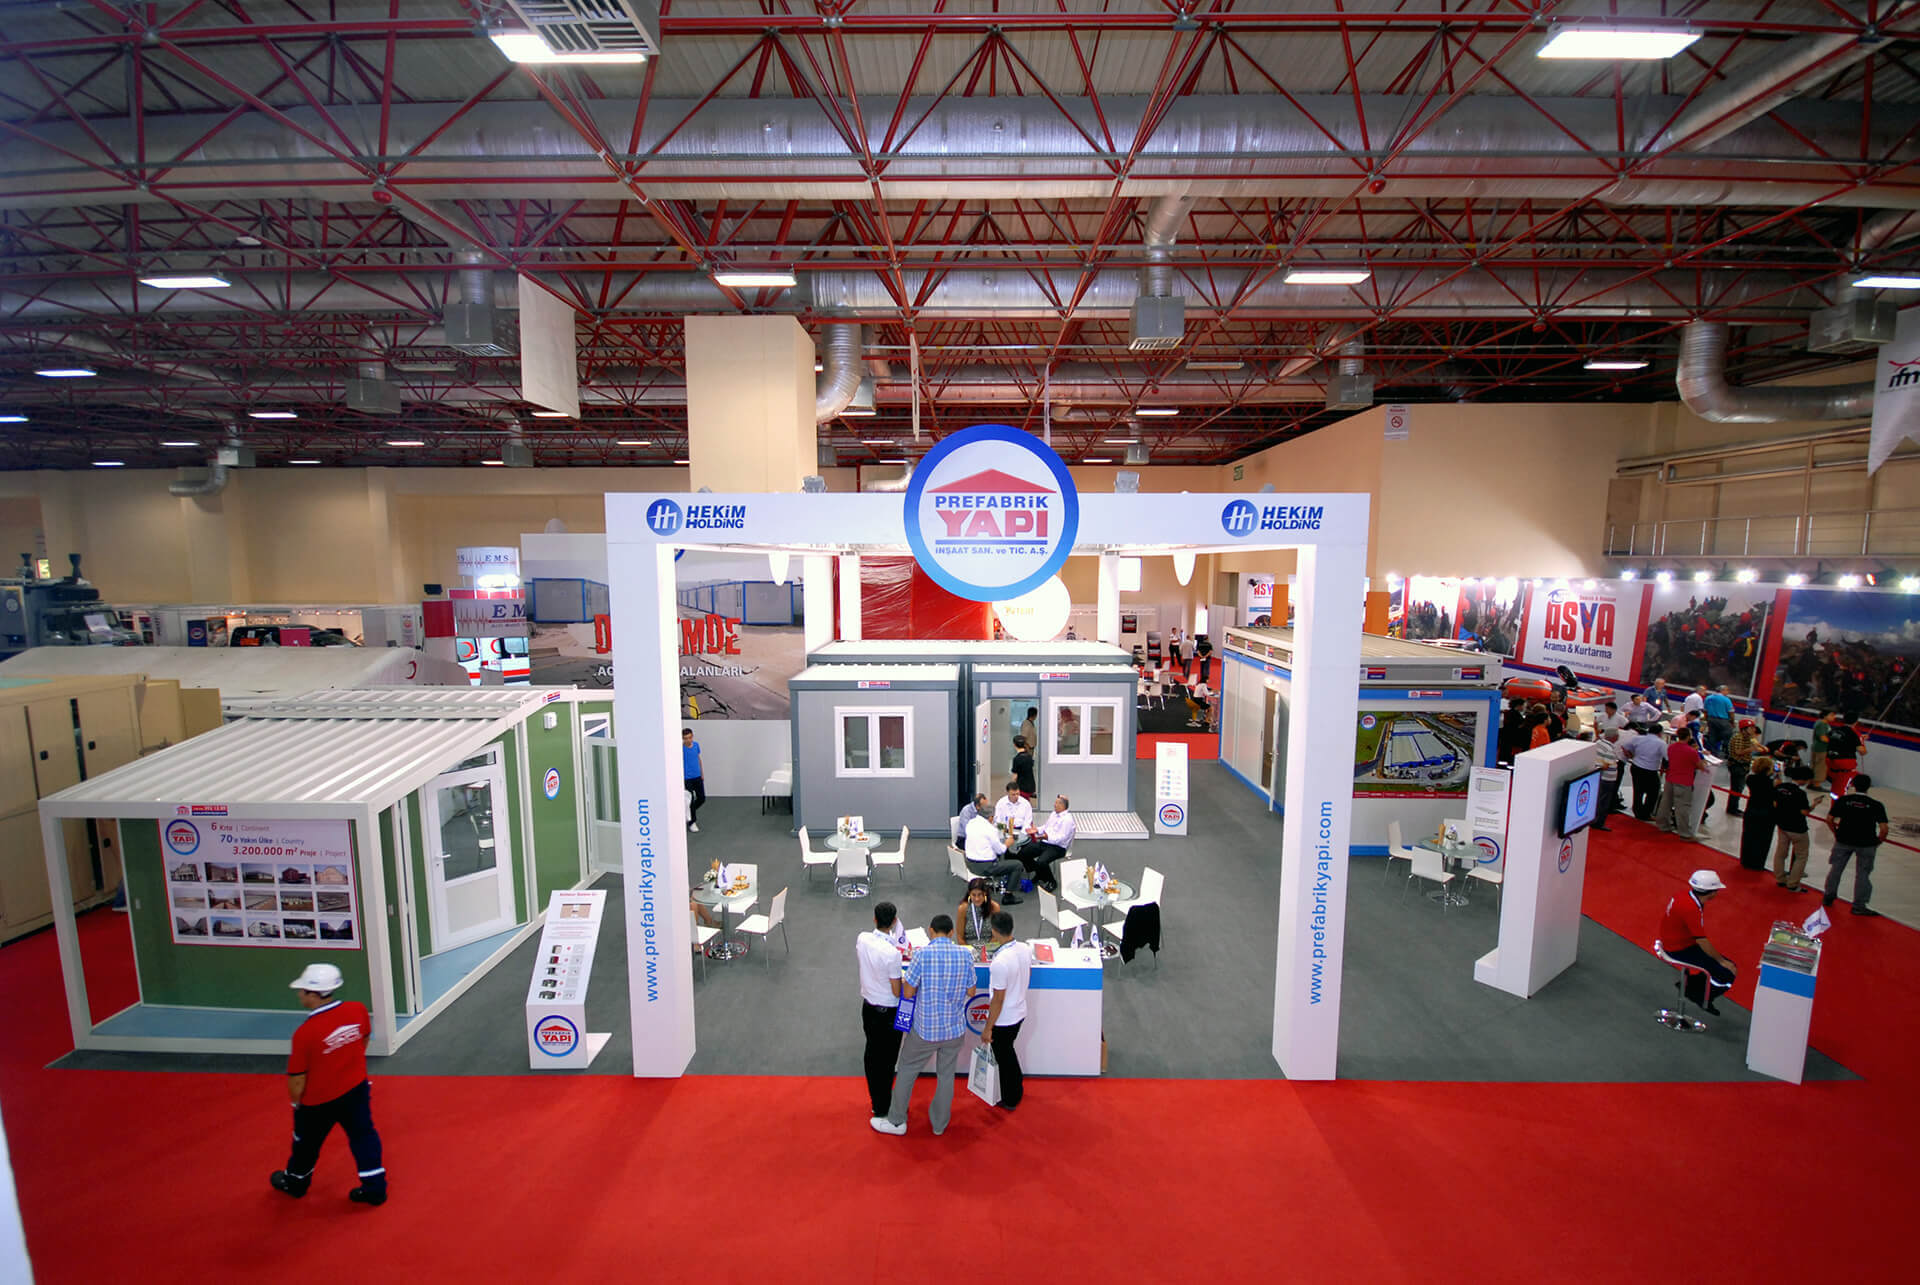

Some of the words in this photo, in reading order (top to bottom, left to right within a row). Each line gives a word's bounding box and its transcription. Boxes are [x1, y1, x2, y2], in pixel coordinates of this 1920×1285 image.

[936, 510, 1048, 537] YAPI
[1254, 584, 1274, 595] ASY
[492, 603, 526, 618] EM
[1544, 600, 1616, 647] ASYA
[1543, 640, 1567, 652] Arama
[1567, 644, 1573, 653] &
[1574, 645, 1613, 659] Kurtarma
[211, 822, 217, 831] 6
[232, 846, 283, 856] 3.200.000
[300, 850, 317, 858] Proje
[636, 799, 659, 1002] www.prefabrikyapi.com
[1310, 801, 1332, 1005] www.prefabrikyapi.com
[543, 1034, 571, 1042] YAPI
